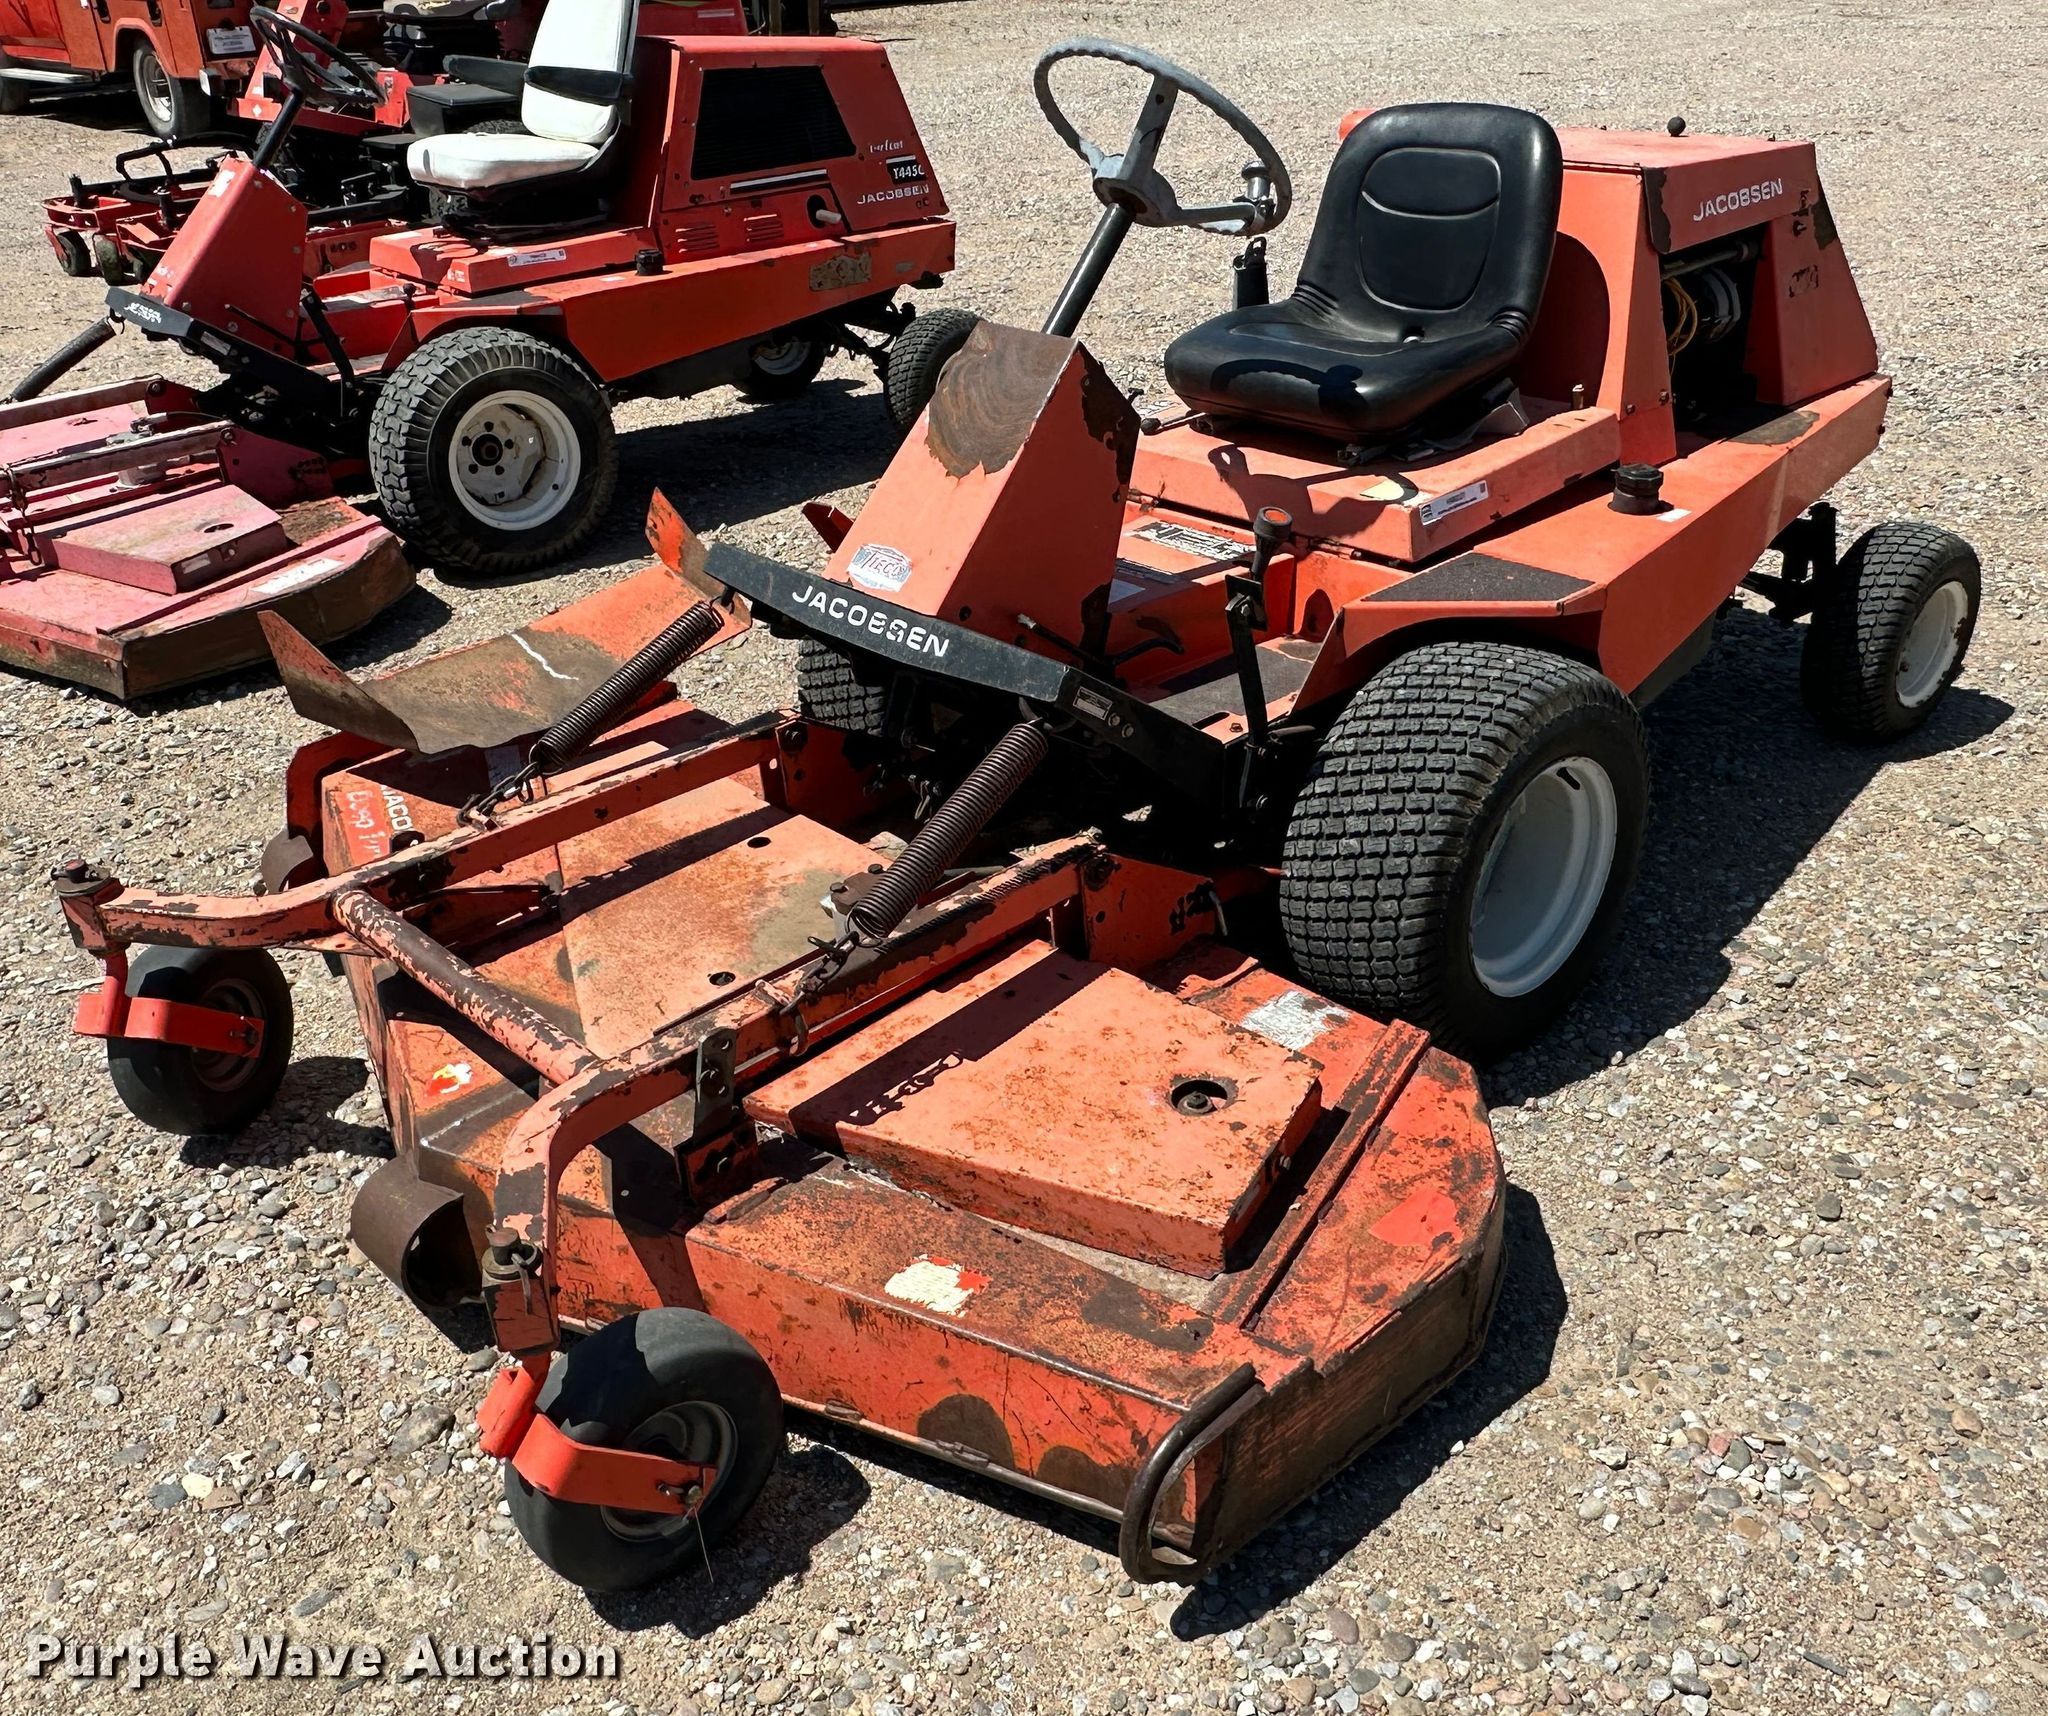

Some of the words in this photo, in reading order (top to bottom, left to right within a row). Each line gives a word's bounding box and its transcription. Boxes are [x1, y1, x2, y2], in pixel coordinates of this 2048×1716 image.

[857, 184, 930, 205] JACOBSEN
[1692, 177, 1783, 222] JACOBSEN
[791, 585, 950, 658] JACOBSEN
